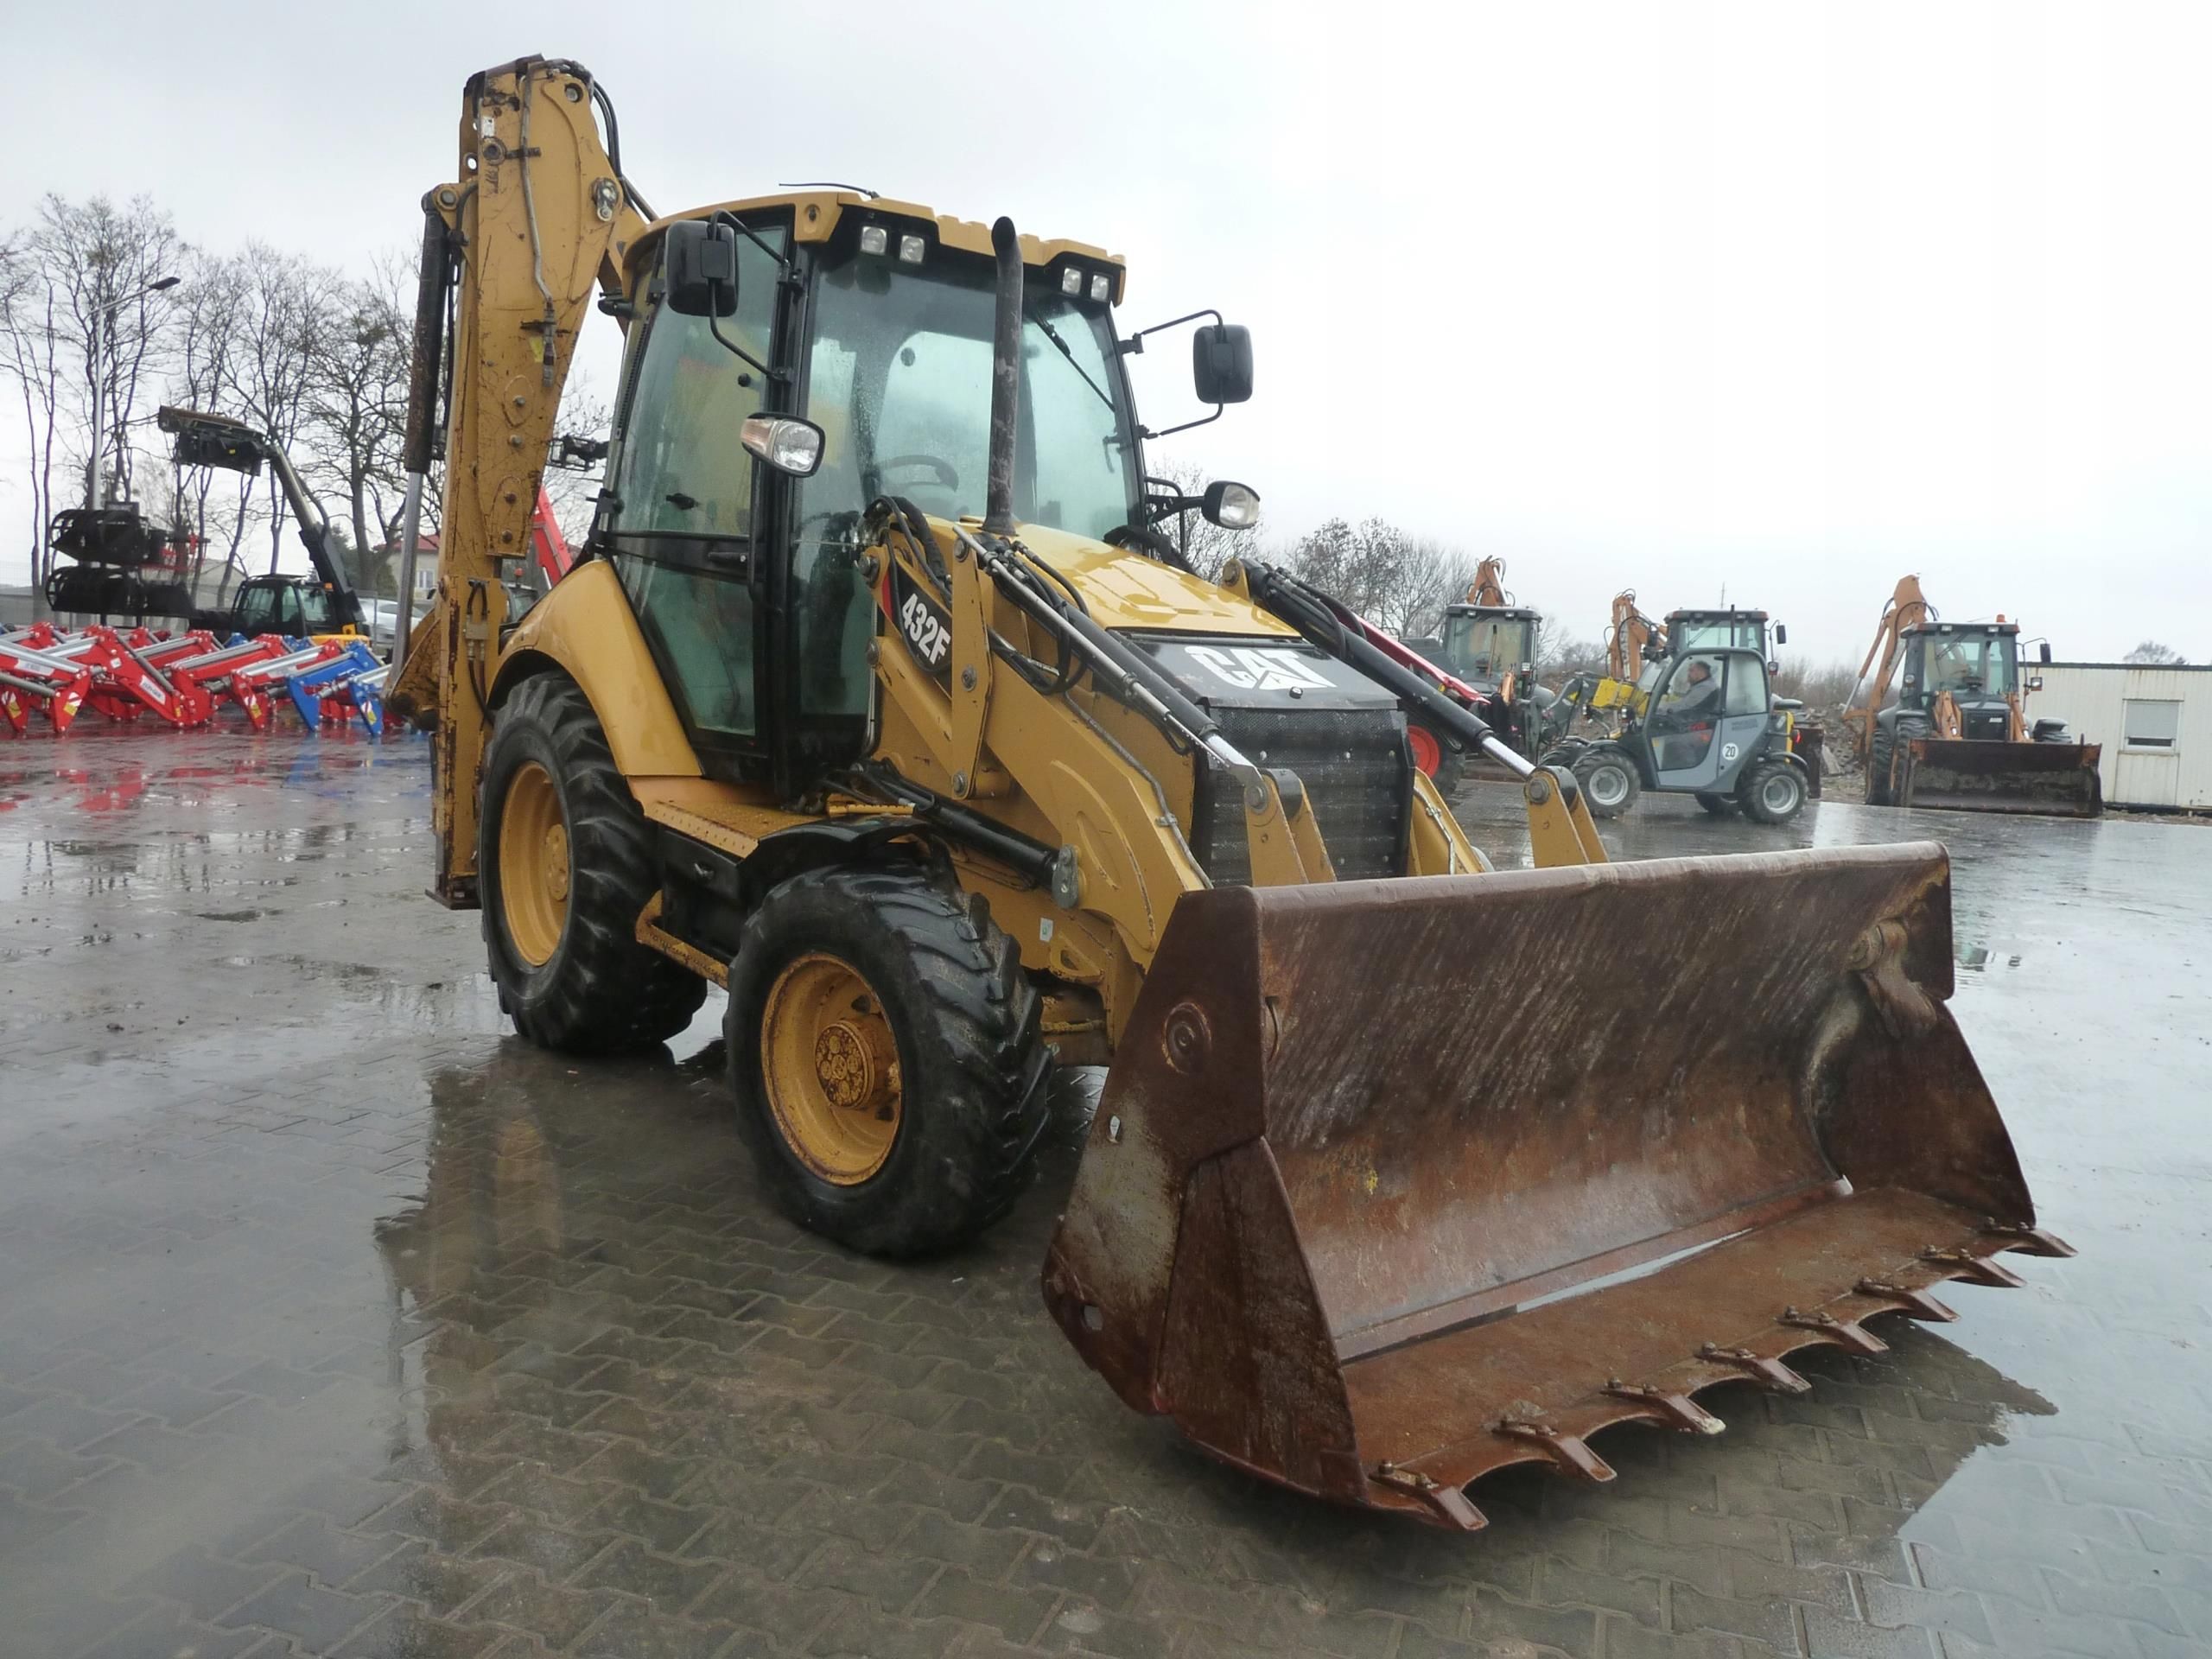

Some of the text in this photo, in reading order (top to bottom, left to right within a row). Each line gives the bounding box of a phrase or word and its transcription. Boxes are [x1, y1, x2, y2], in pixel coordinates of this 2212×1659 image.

[901, 593, 951, 664] 432F
[1185, 645, 1338, 690] CAT
[1725, 746, 1736, 758] 20
